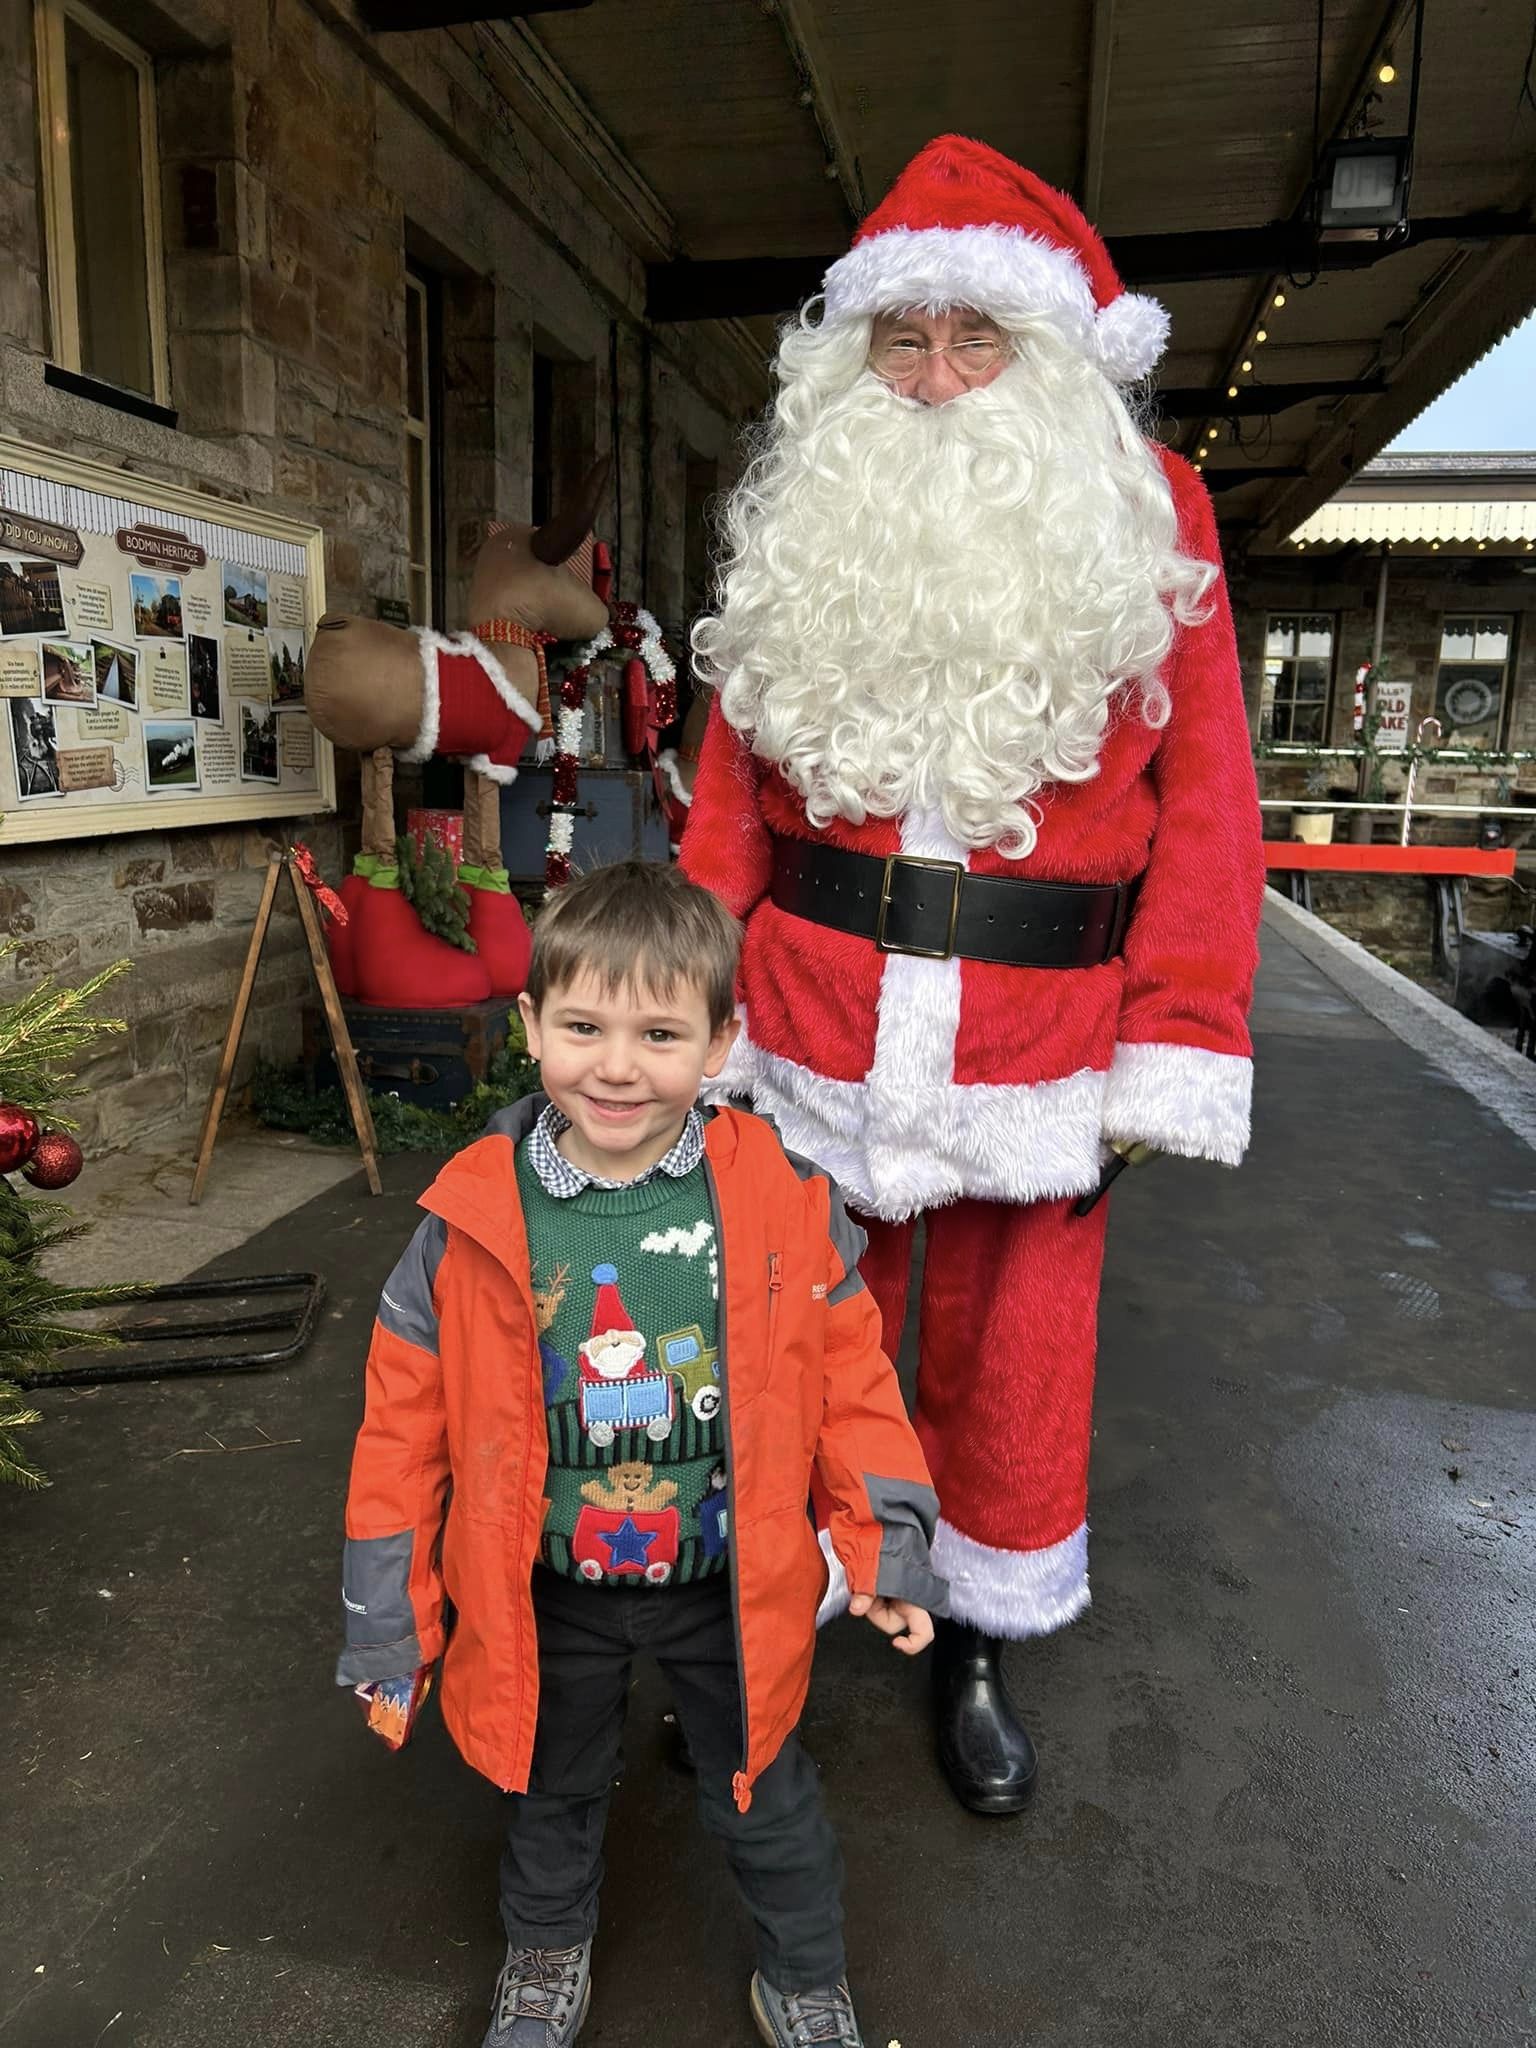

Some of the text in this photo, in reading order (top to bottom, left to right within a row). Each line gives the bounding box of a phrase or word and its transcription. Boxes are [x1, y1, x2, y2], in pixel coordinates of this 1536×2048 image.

[6, 523, 21, 538] DID
[23, 528, 42, 545] YOU
[126, 535, 198, 562] BODMIN HERITAGE
[1377, 699, 1405, 713] OLD
[1380, 716, 1406, 731] AKE
